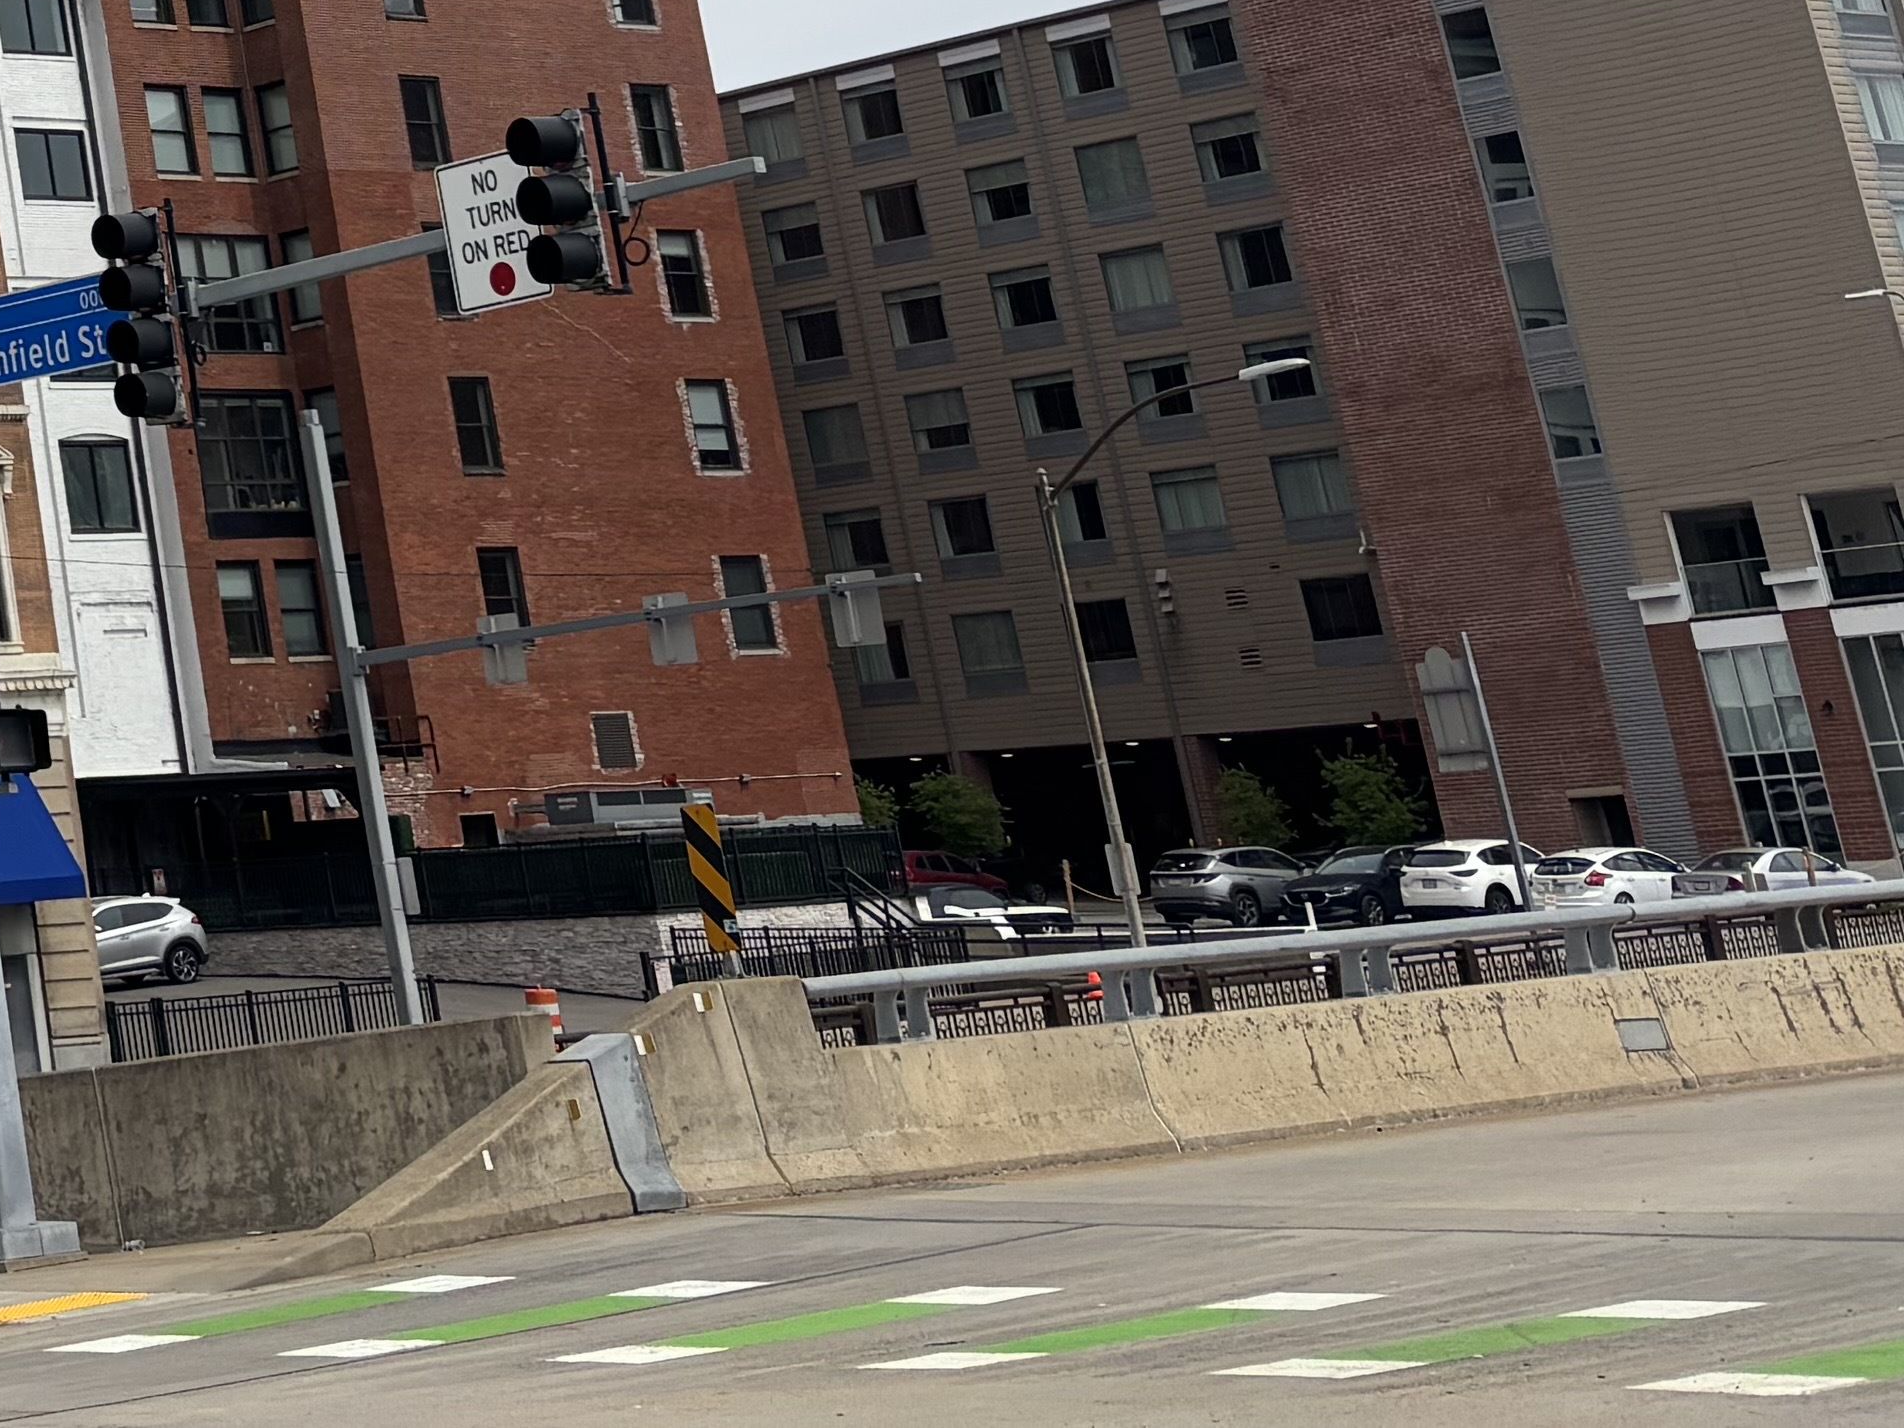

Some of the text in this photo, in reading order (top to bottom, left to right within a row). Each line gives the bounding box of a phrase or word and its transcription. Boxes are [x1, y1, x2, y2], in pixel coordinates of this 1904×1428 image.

[471, 169, 497, 195] NO
[465, 197, 517, 229] TURN
[462, 229, 531, 264] ON RED
[78, 324, 106, 358] St
